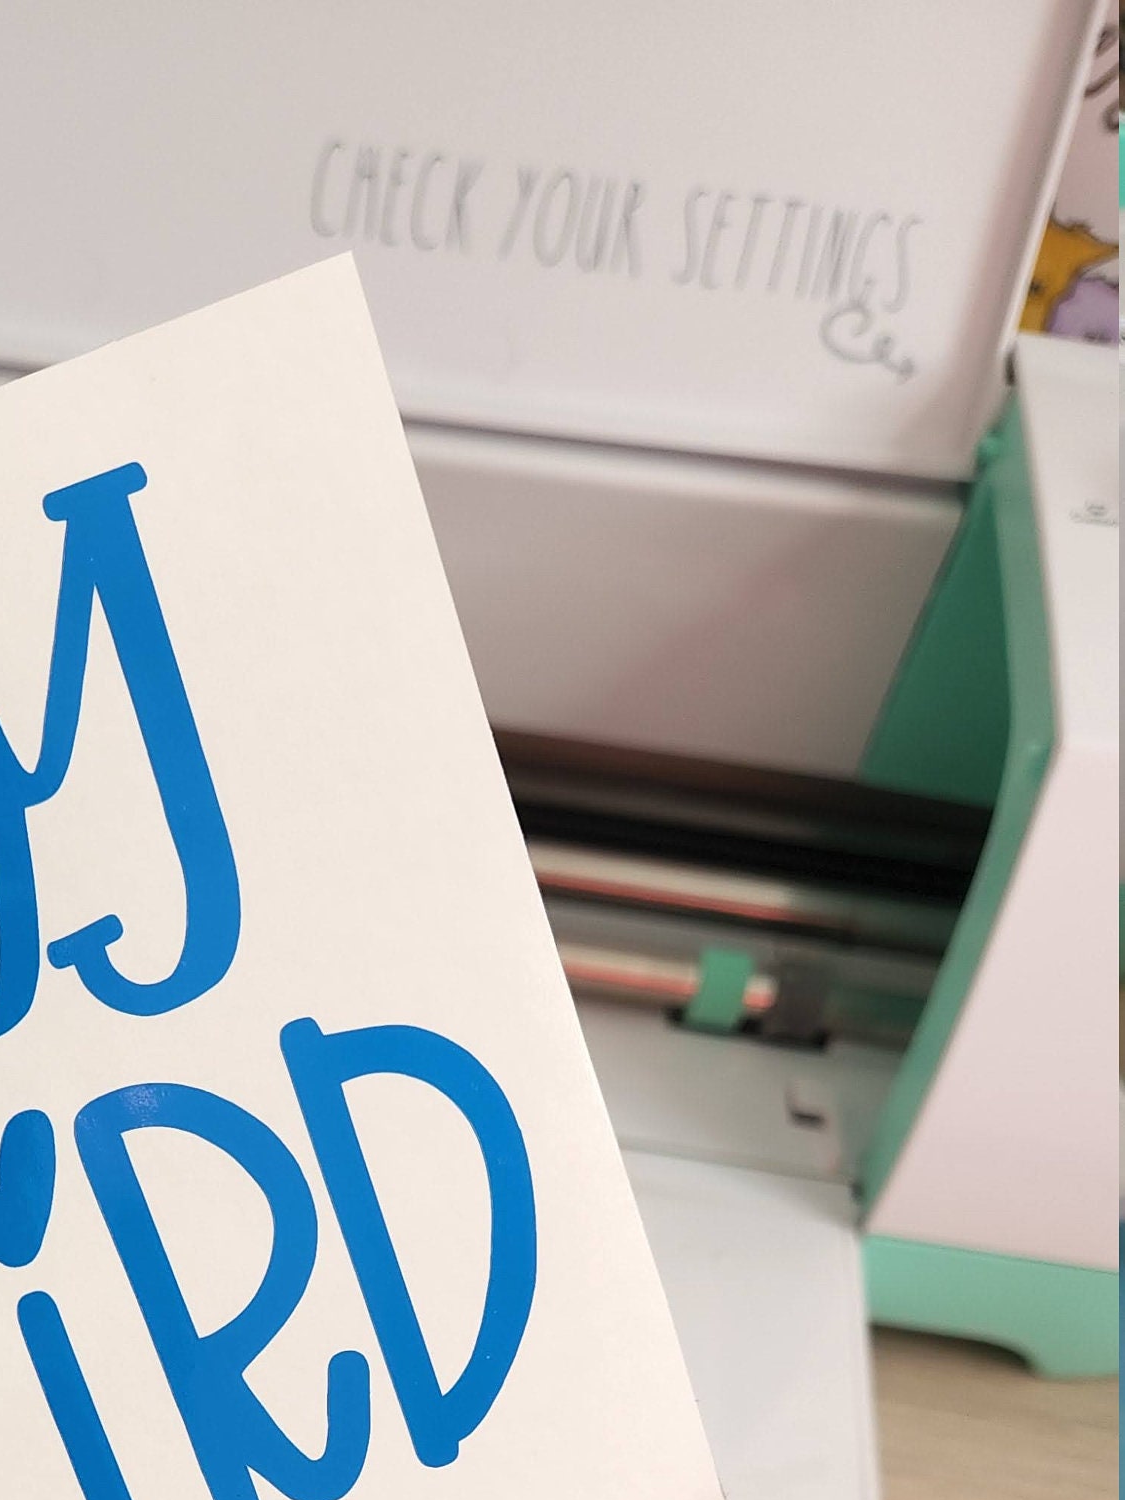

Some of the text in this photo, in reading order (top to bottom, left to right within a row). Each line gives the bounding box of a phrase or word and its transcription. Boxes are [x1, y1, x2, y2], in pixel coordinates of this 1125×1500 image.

[309, 140, 924, 315] CHECK YOUR SETTINGS
